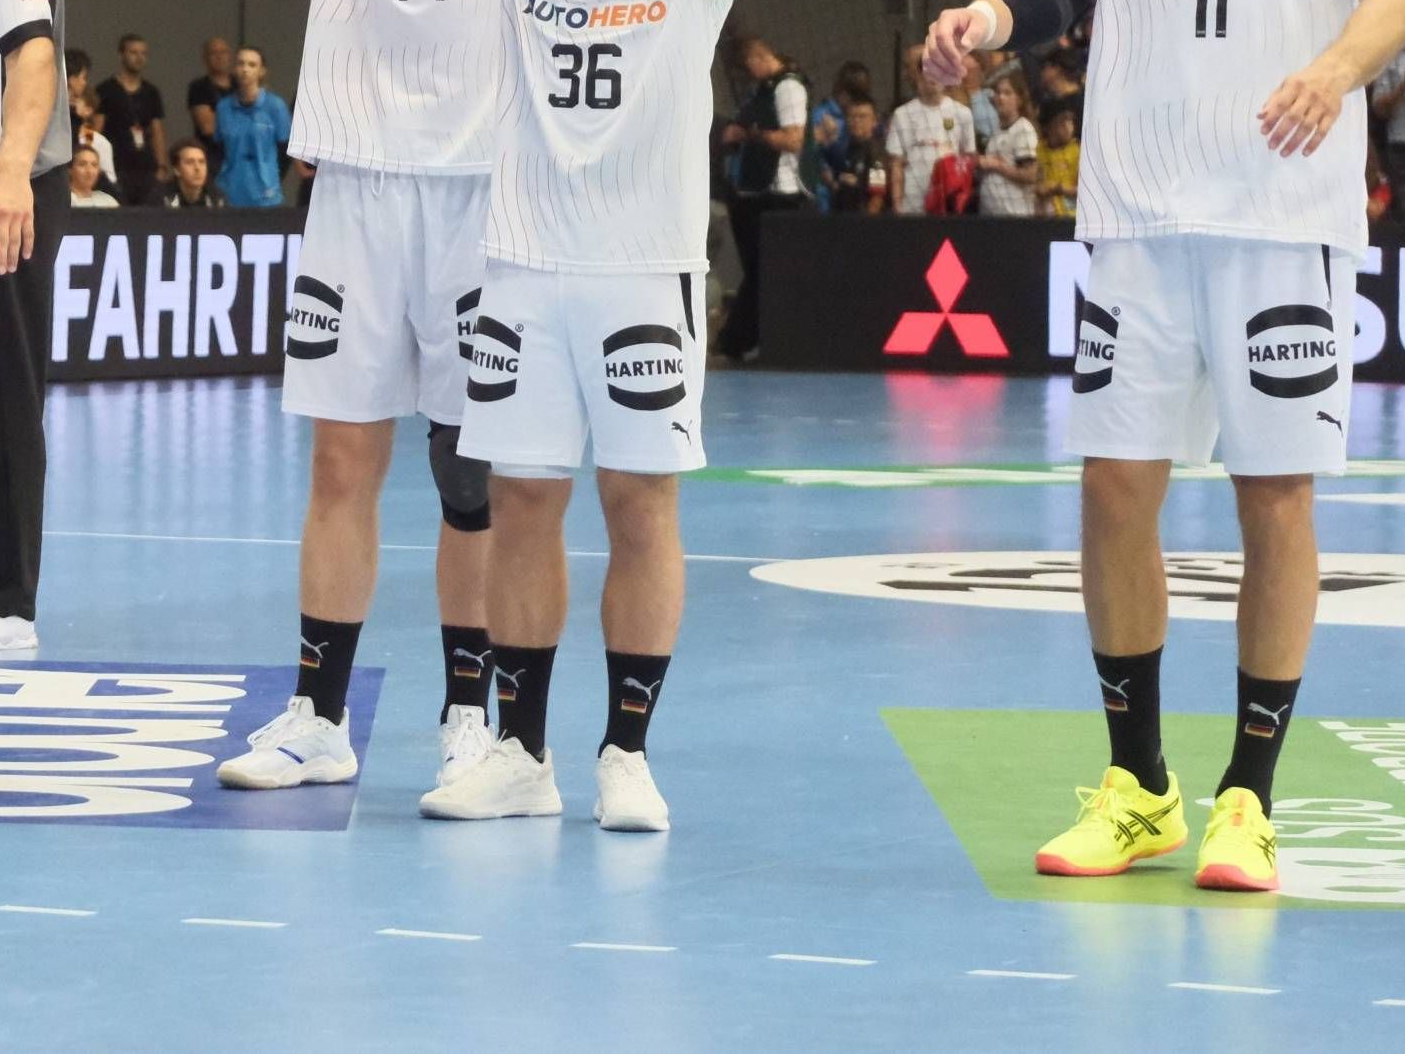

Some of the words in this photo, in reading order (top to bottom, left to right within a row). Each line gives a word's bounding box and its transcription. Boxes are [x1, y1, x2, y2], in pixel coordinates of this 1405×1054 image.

[548, 43, 622, 109] 36
[291, 307, 340, 333] RTING
[473, 349, 518, 373] RTING
[1248, 340, 1336, 362] HARTING
